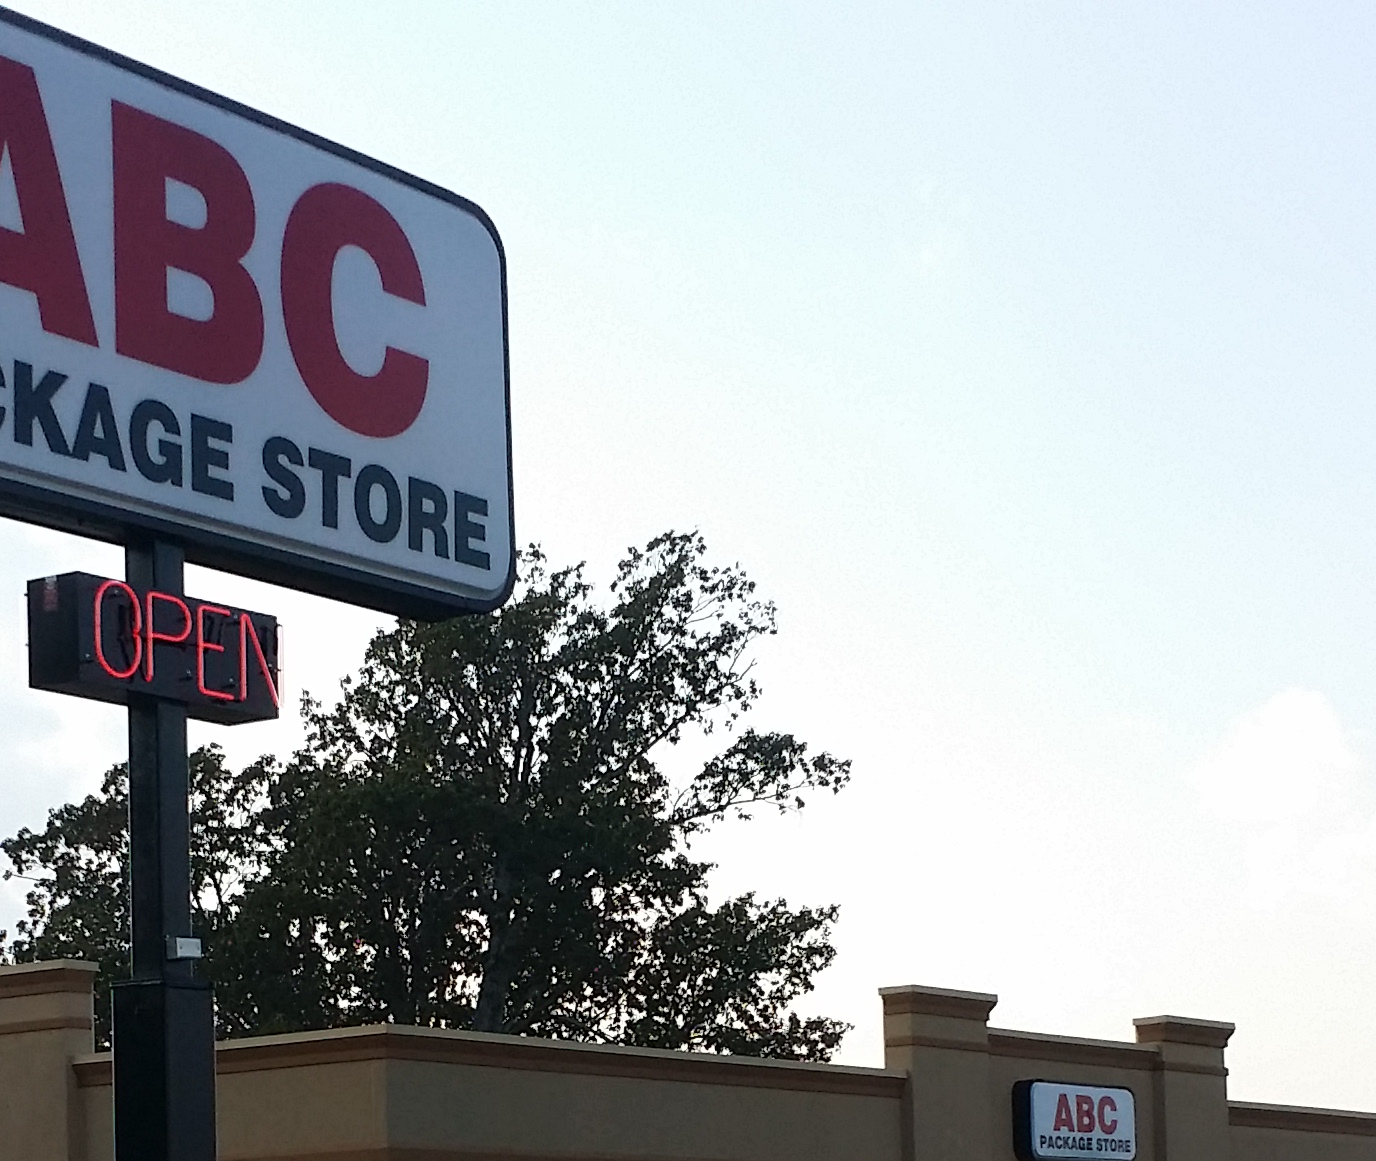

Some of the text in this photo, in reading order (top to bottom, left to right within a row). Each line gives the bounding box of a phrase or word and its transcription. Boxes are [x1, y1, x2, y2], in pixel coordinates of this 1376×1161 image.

[261, 435, 491, 570] STORE
[93, 579, 285, 708] OPEN
[1040, 1134, 1131, 1153] PACKAGE STORE
[1053, 1093, 1118, 1135] ABC
